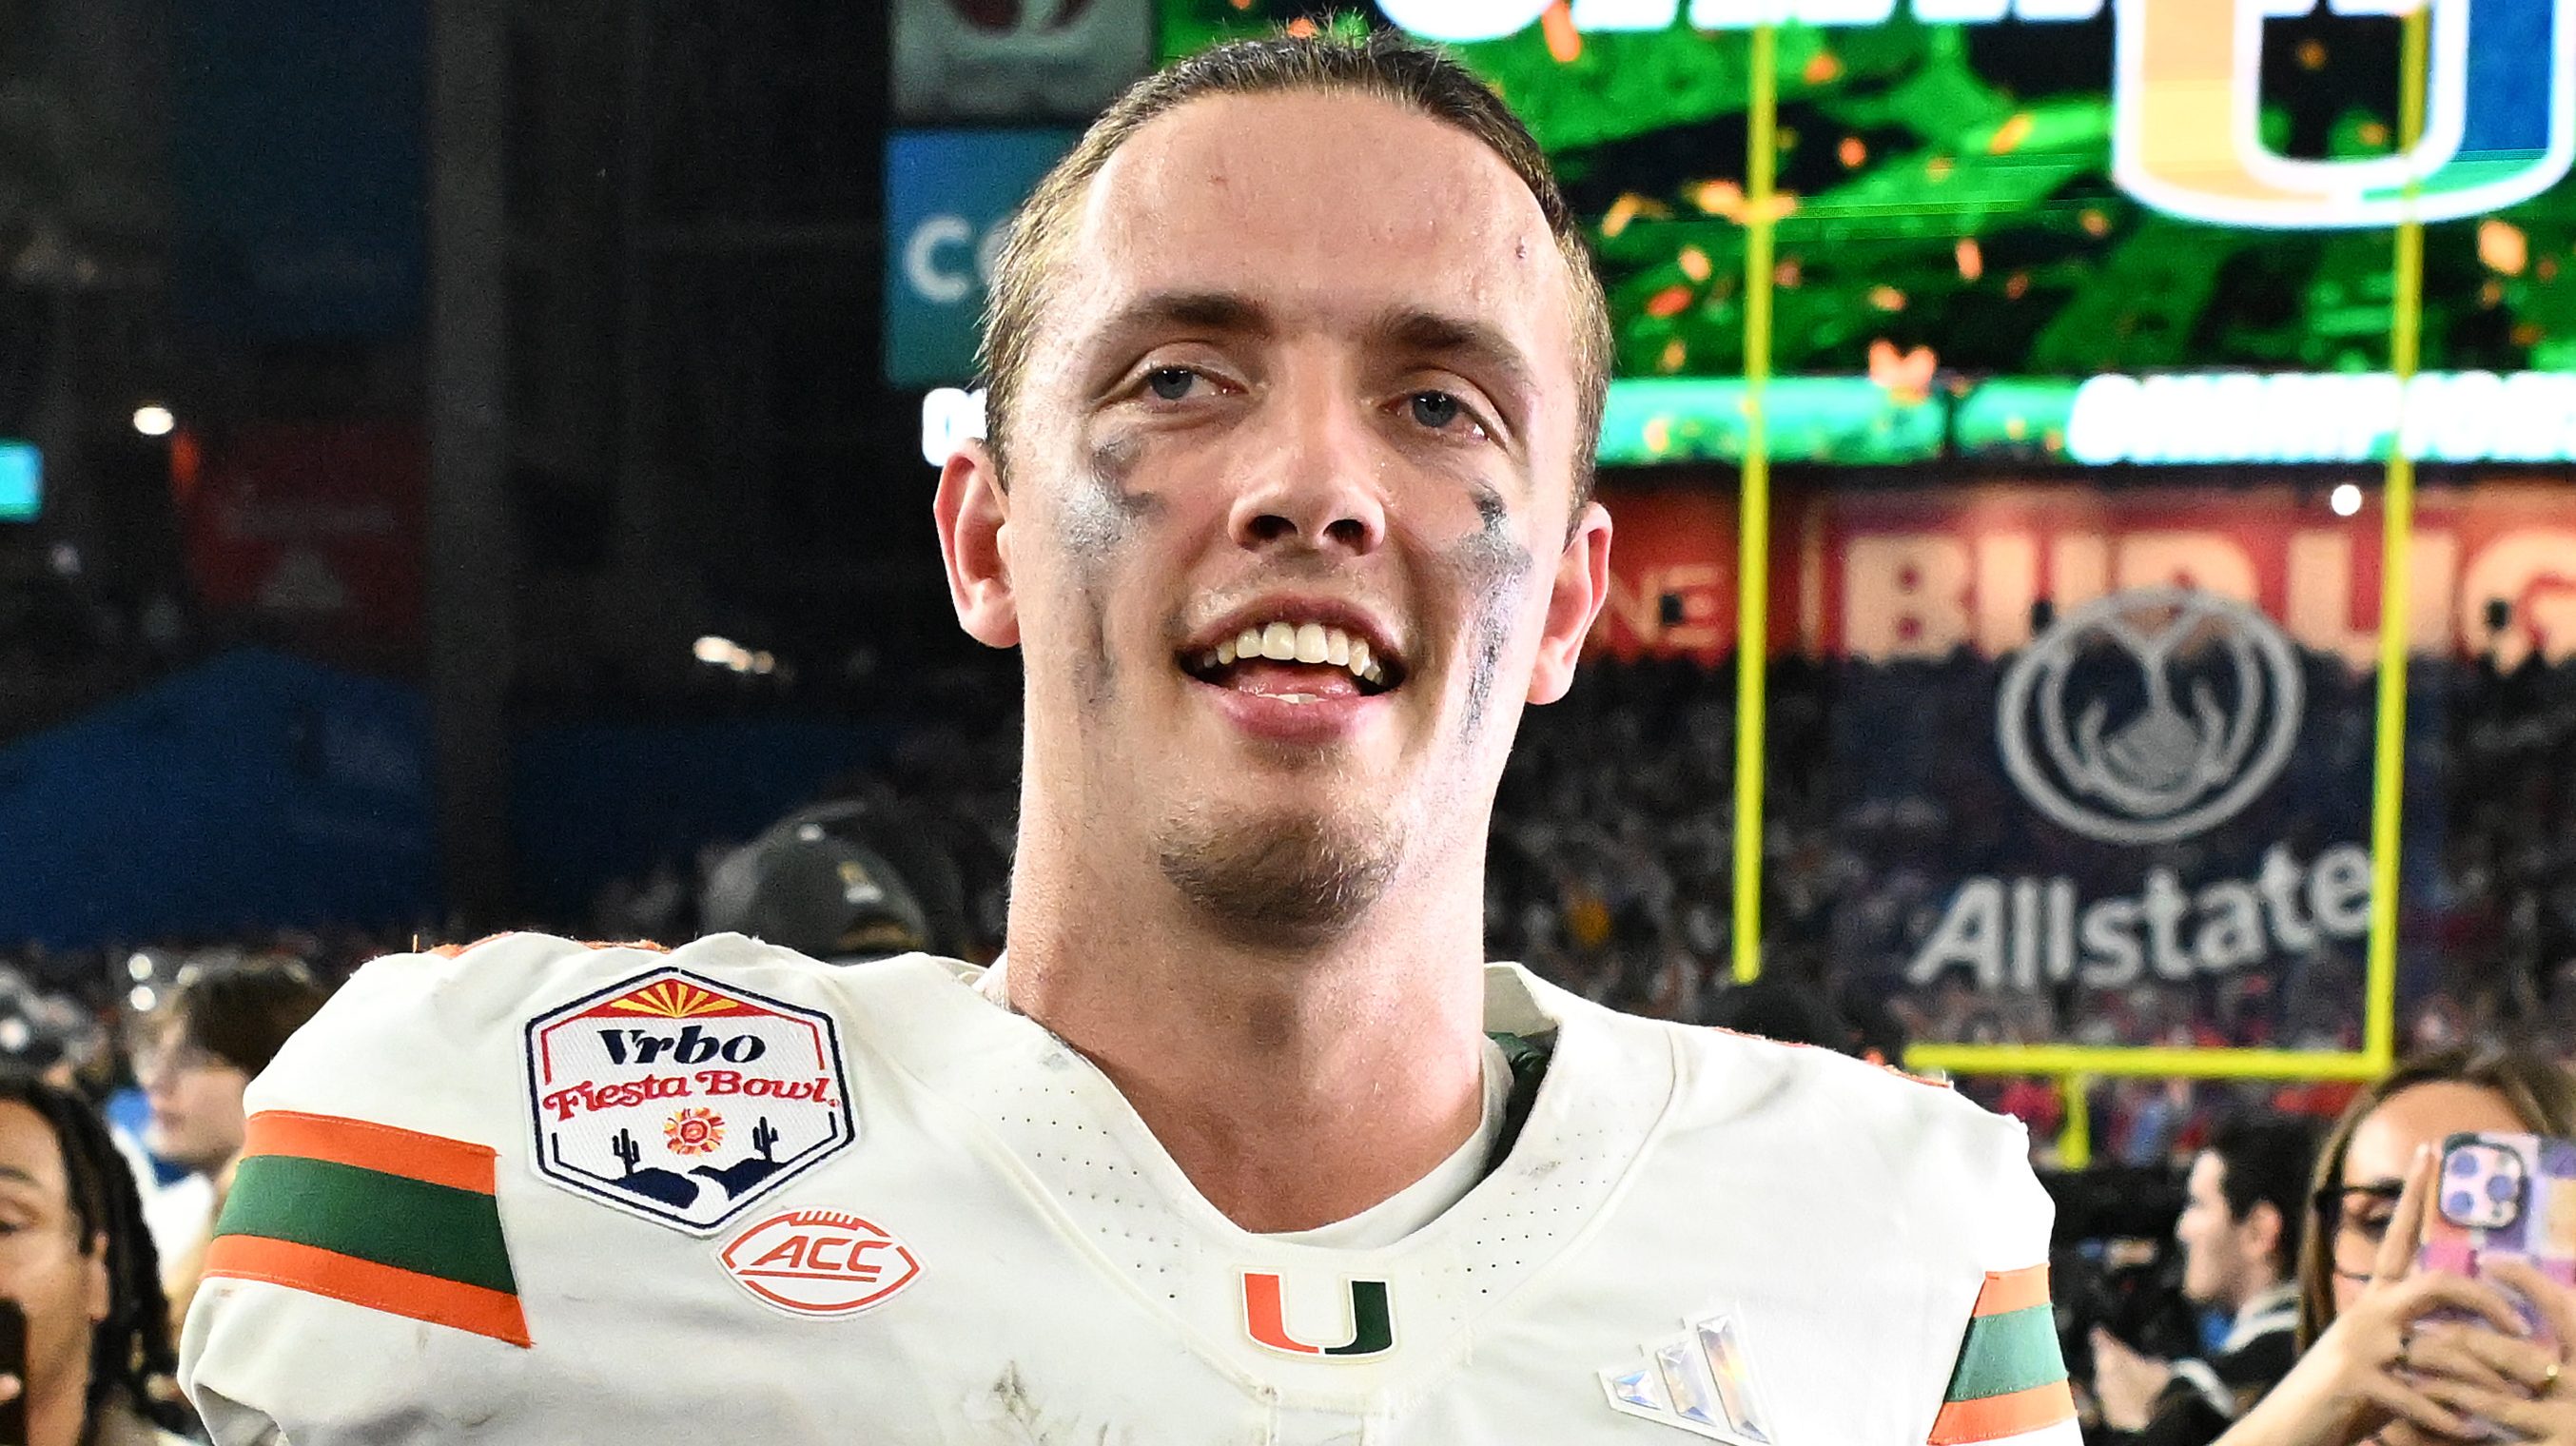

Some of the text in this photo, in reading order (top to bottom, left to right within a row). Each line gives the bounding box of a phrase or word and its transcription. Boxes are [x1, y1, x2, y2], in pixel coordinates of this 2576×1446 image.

[1904, 843, 2372, 989] Allstate
[596, 1025, 767, 1065] Vrbo
[542, 1069, 830, 1122] Fiesta Bowl
[750, 1235, 893, 1274] ACC
[1242, 1271, 1394, 1356] U
